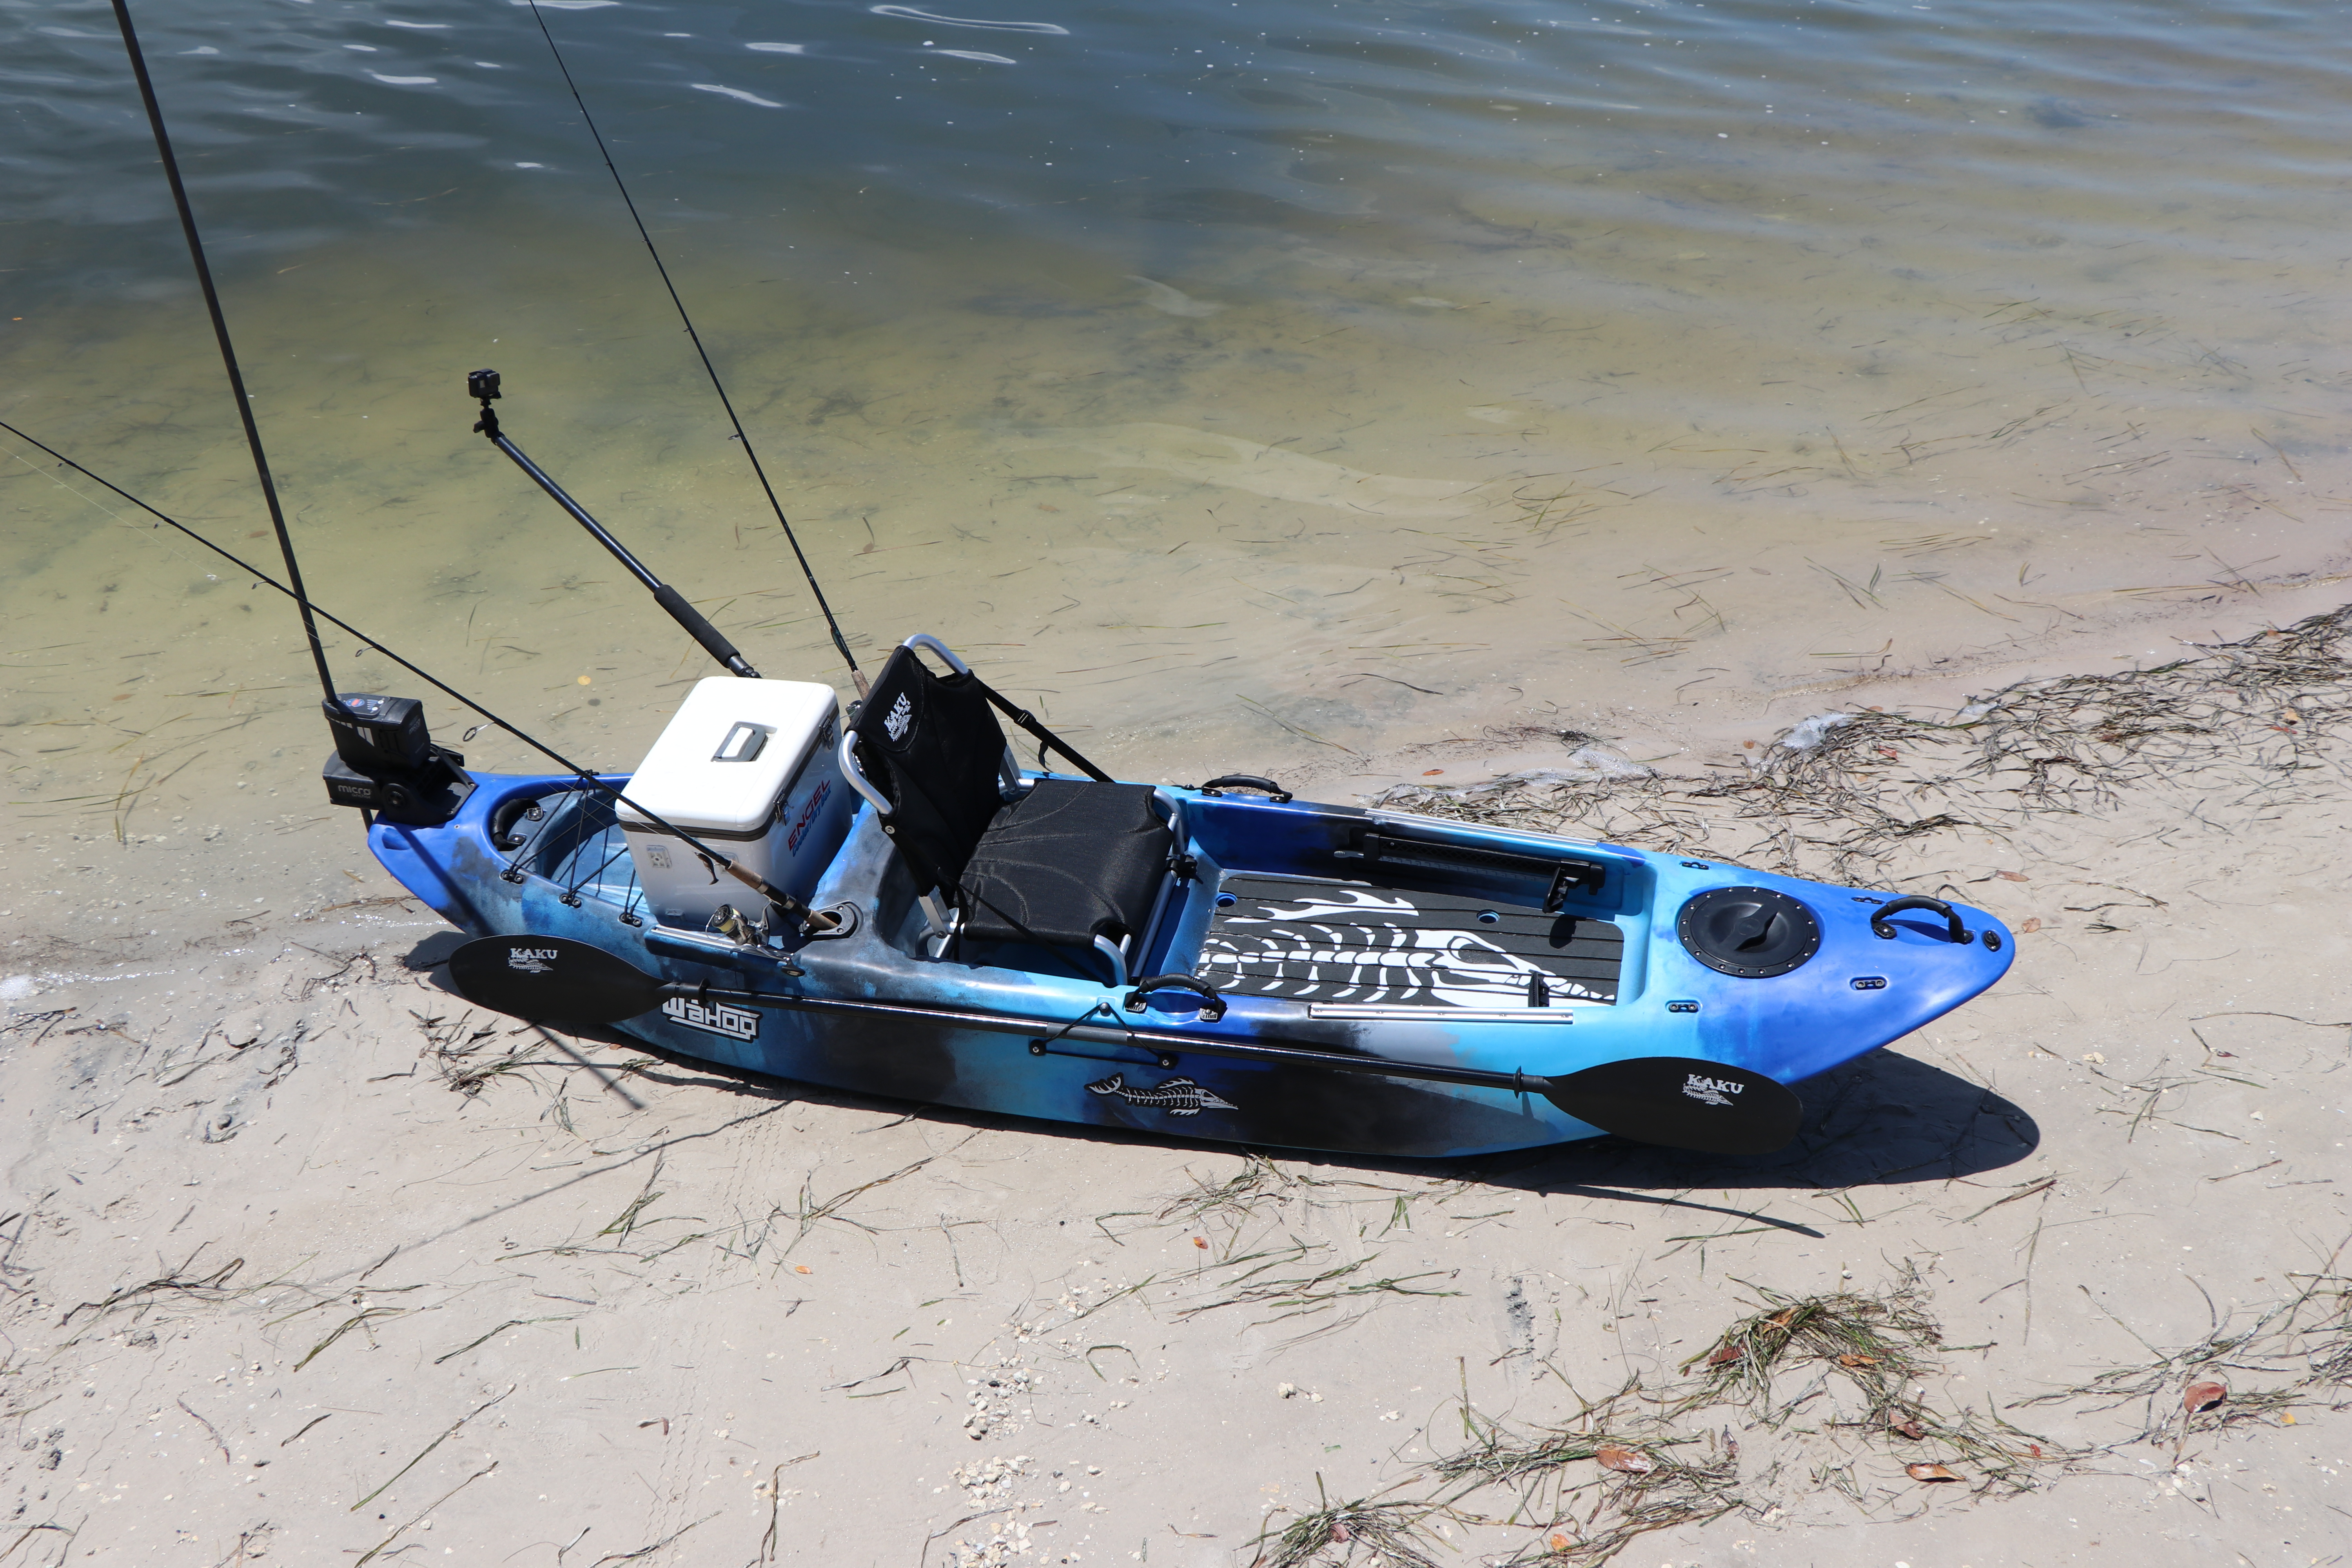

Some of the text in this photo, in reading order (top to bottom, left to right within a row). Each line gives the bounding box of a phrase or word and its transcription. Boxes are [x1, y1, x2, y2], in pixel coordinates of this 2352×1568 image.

[884, 691, 907, 732] KAKU
[338, 785, 371, 795] micro
[788, 779, 830, 851] ENGEL
[510, 948, 558, 959] KAKU
[1687, 1074, 1744, 1094] KAKU
